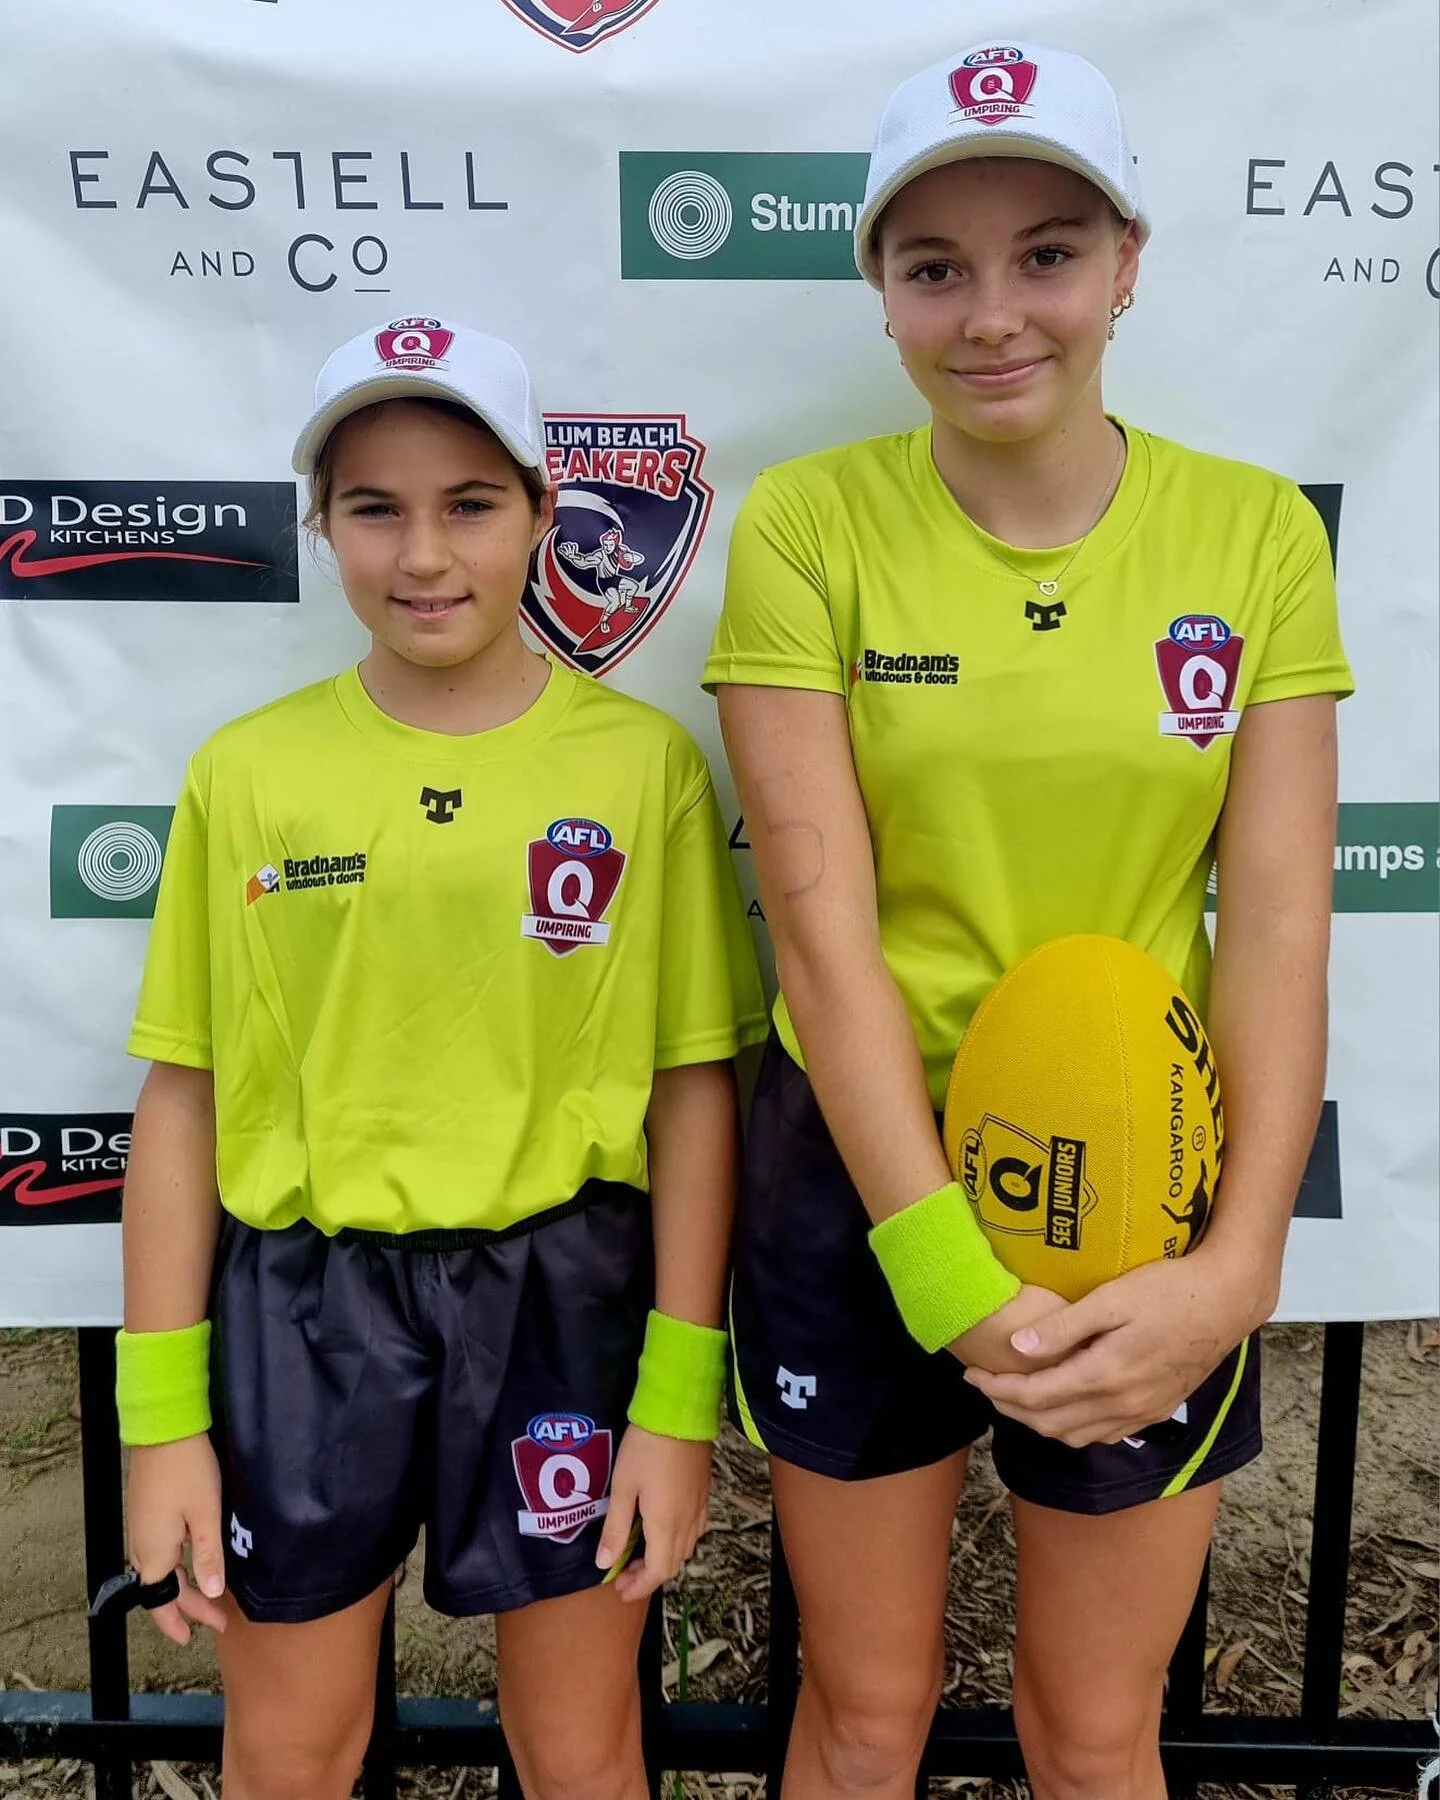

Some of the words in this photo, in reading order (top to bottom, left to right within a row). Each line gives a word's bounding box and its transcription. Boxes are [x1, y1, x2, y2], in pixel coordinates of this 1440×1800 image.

[970, 48, 1017, 62] AFL
[969, 67, 1017, 102] Q
[964, 104, 1020, 117] UMPIRING
[69, 150, 509, 211] EASTELL
[1246, 159, 1439, 219] EAS
[170, 251, 255, 277] AND
[1323, 257, 1400, 283] AND
[392, 331, 432, 357] Q
[386, 358, 436, 367] UMPIRING
[597, 427, 674, 447] BEACH
[50, 495, 248, 535] Design
[50, 530, 175, 544] KITCHENS
[1176, 622, 1226, 641] AFL
[864, 649, 959, 672] Bradnam's
[914, 672, 923, 684] &
[925, 672, 958, 685] doors
[1179, 655, 1227, 709] Q
[552, 825, 606, 850] AFL
[283, 852, 366, 878] Bradnam's
[327, 873, 335, 885] &
[336, 872, 365, 885] doors
[547, 860, 592, 920] Q
[535, 919, 592, 938] UMPIRING
[1168, 1062, 1184, 1198] KANGAROO
[964, 1136, 981, 1198] AFL
[1053, 1141, 1077, 1213] JUNIORS
[989, 1157, 1043, 1212] Q
[1052, 1215, 1075, 1246] SEQ
[535, 1421, 589, 1441] AFL
[539, 1454, 592, 1510] Q
[537, 1503, 597, 1529] UMPIRING
